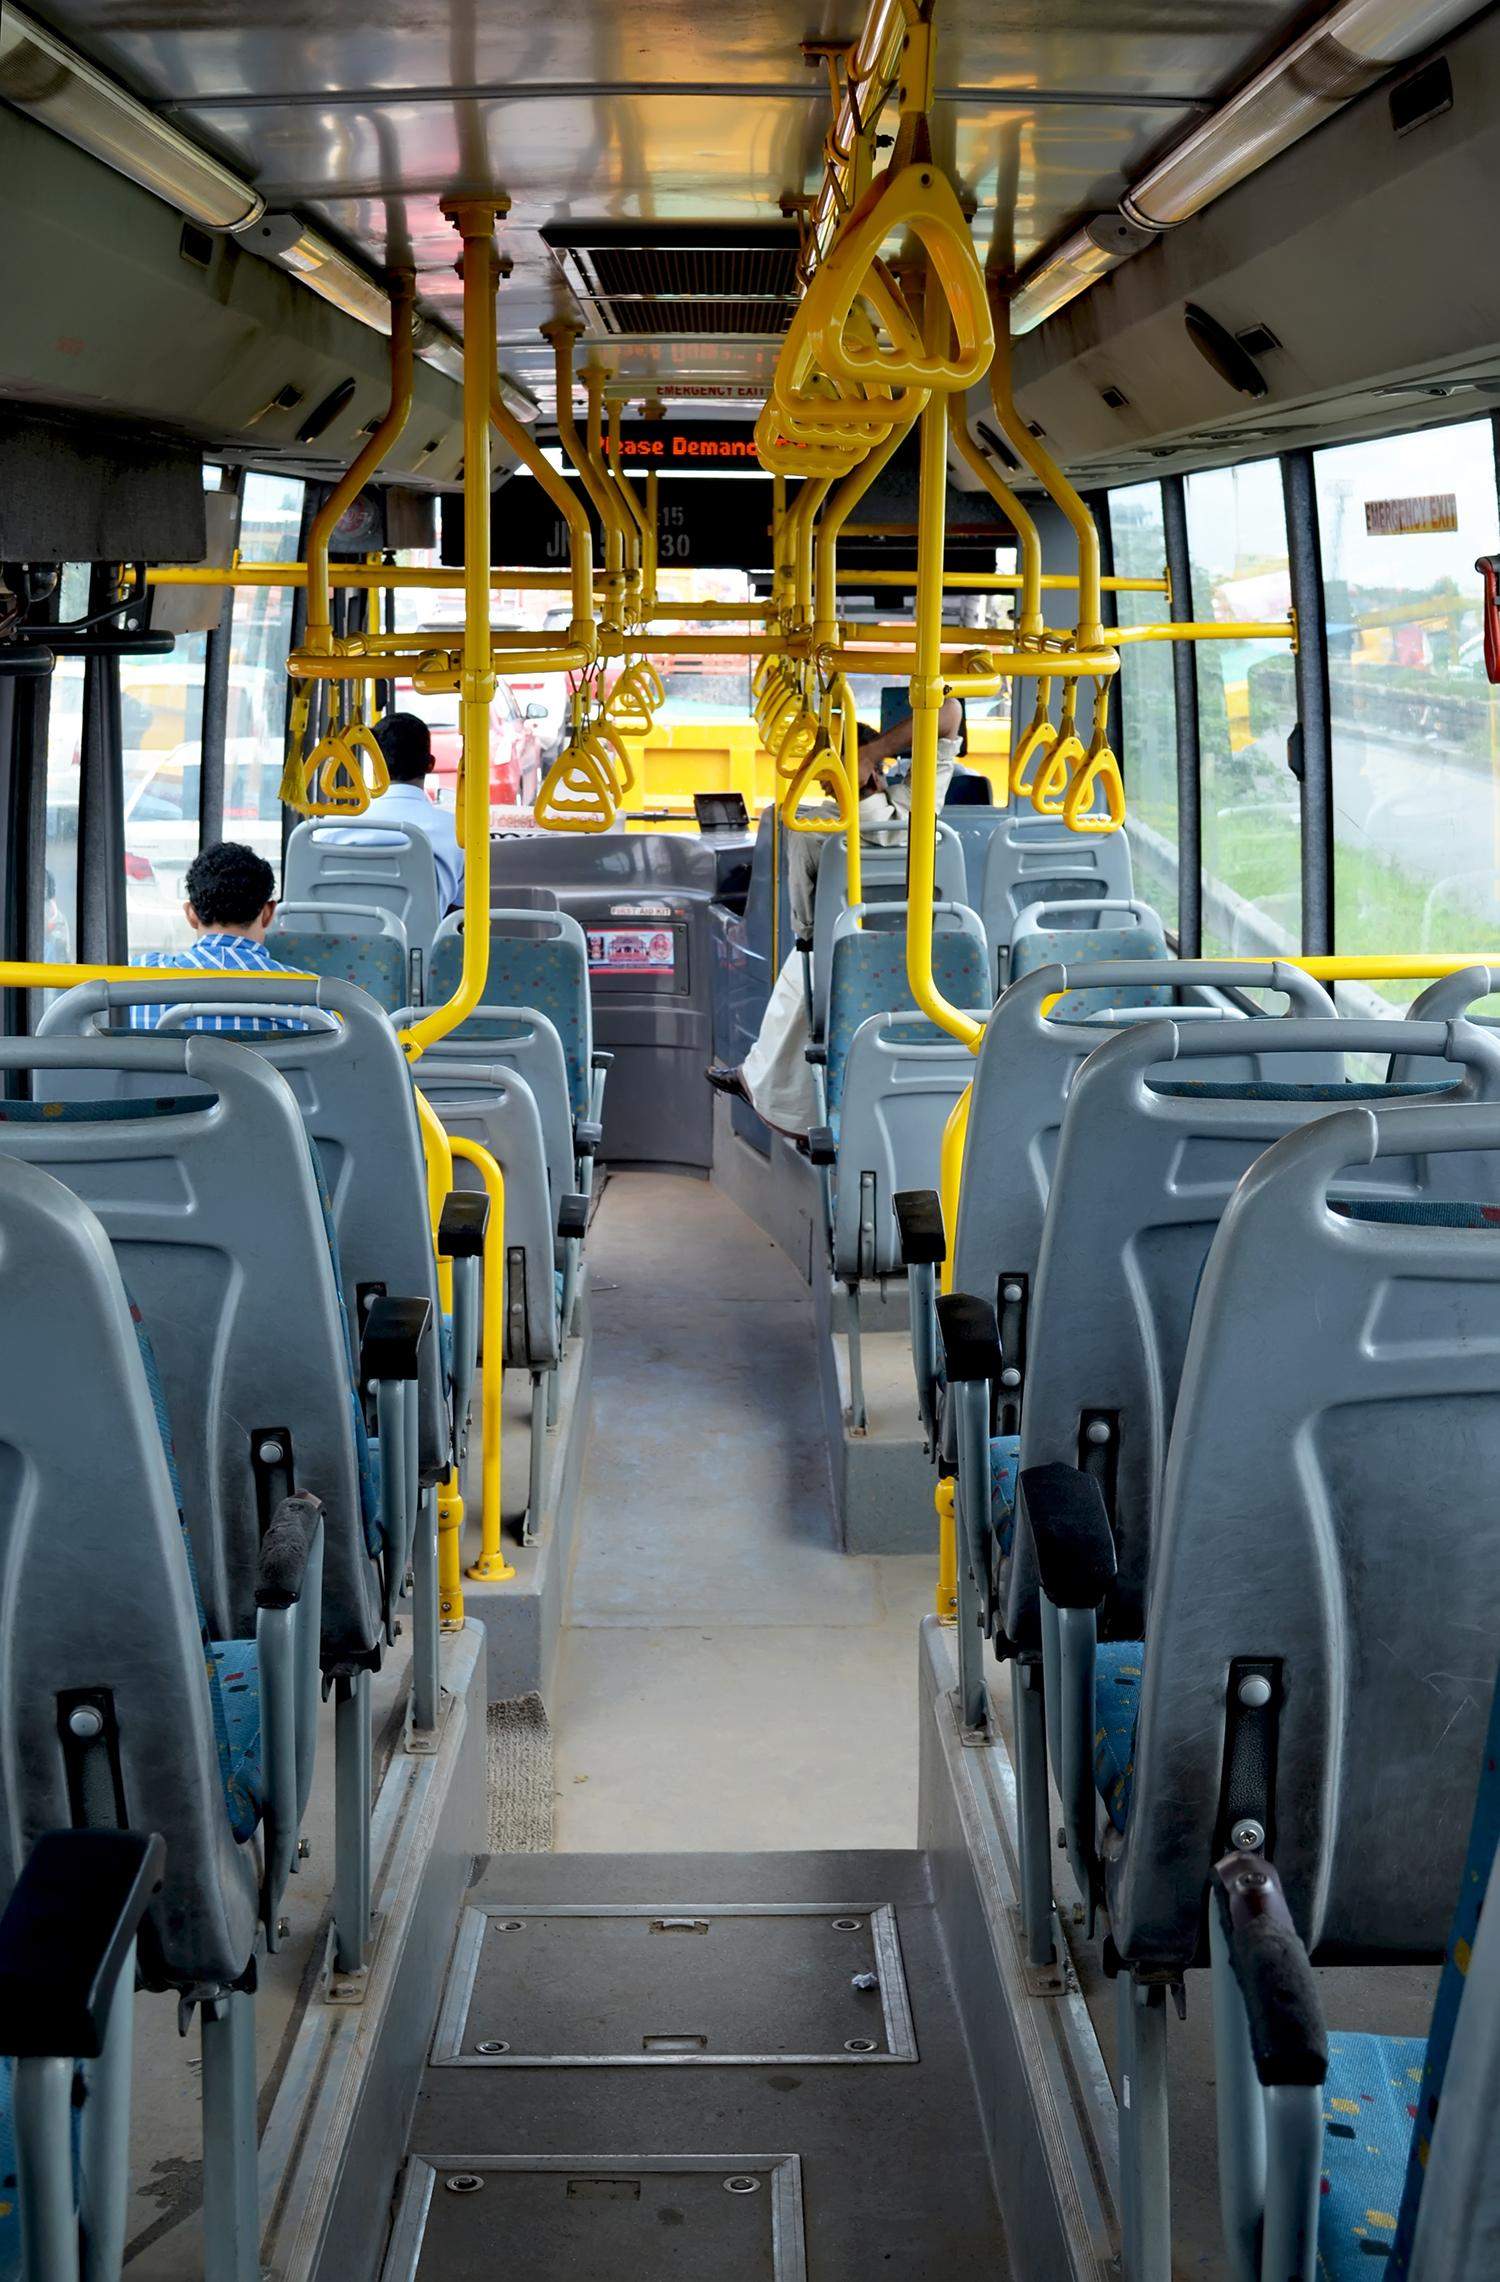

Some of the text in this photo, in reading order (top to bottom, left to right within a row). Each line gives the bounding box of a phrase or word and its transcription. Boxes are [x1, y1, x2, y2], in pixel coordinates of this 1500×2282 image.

[656, 386, 765, 396] EMERGENCY EXIT
[1364, 494, 1457, 532] EMERGENCY EXIT
[660, 533, 691, 558] 30
